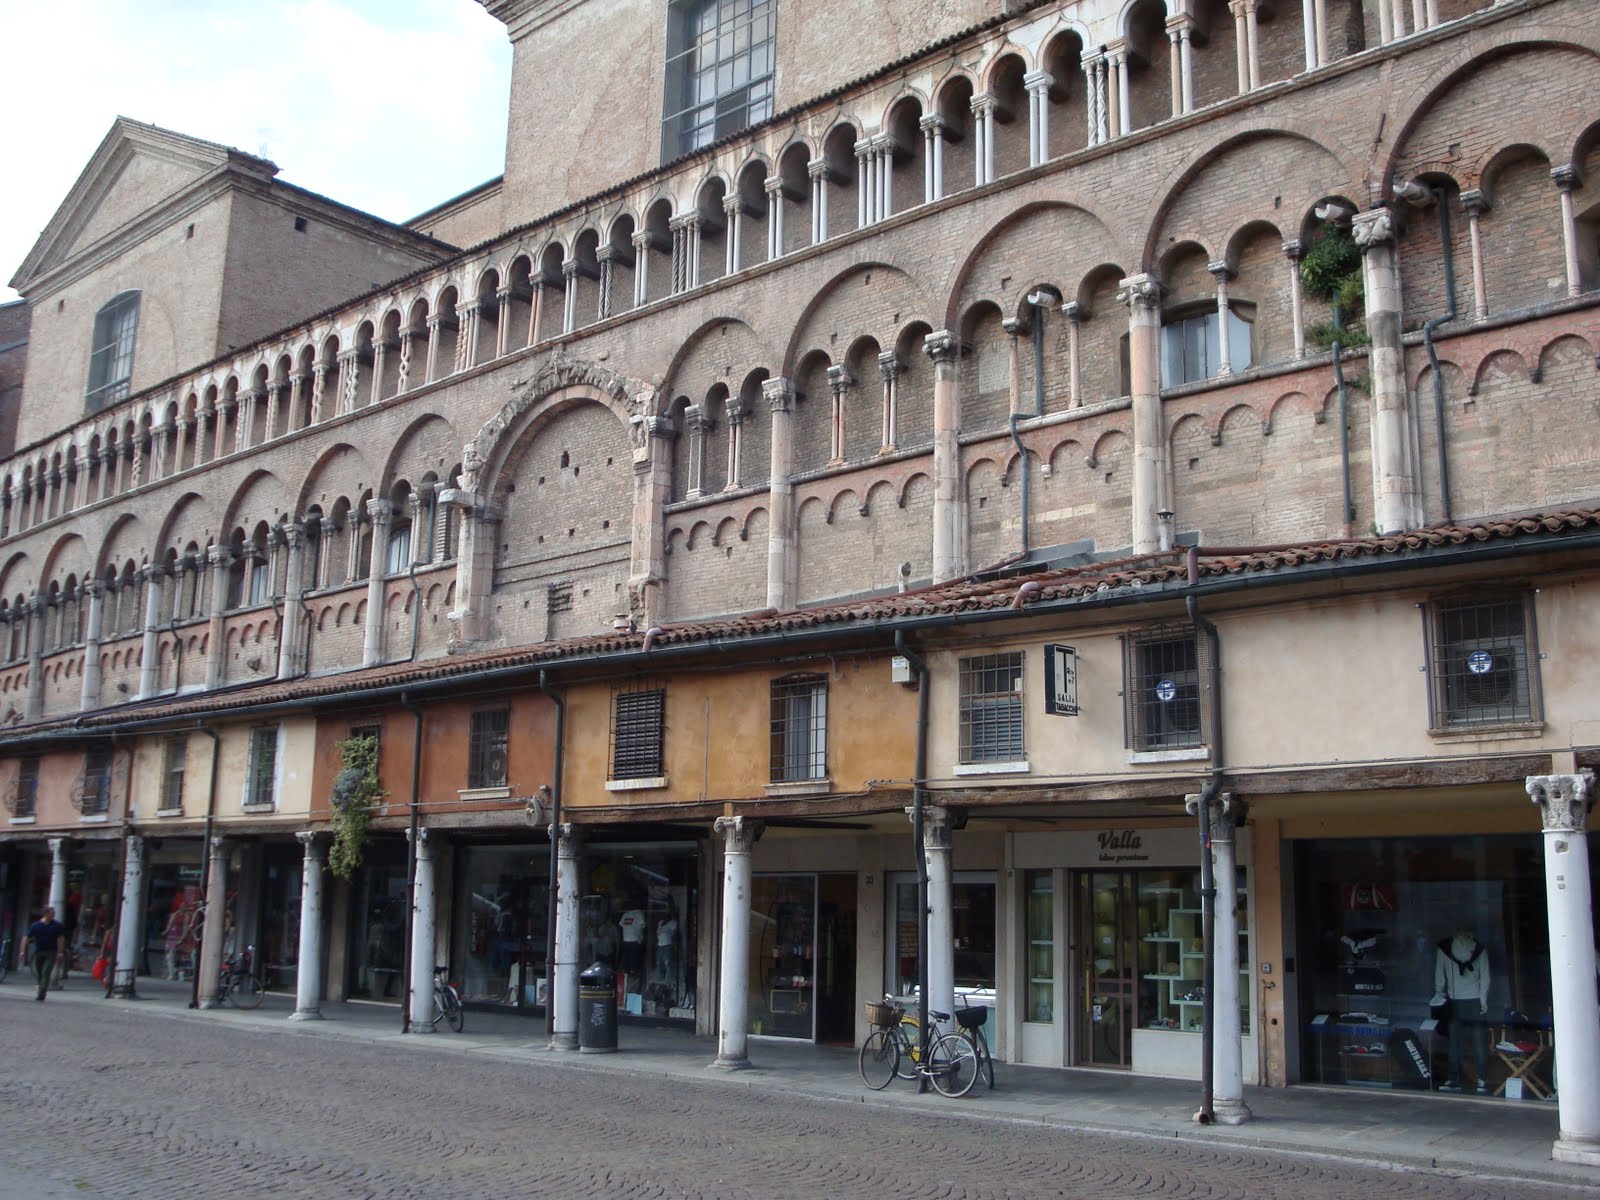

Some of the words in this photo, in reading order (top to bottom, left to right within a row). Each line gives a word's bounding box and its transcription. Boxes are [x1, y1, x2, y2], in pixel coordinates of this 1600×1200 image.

[1057, 693, 1071, 703] SALI
[1098, 830, 1142, 850] Valla
[1404, 1039, 1421, 1061] NORTH
[1415, 1059, 1431, 1078] SAILS
